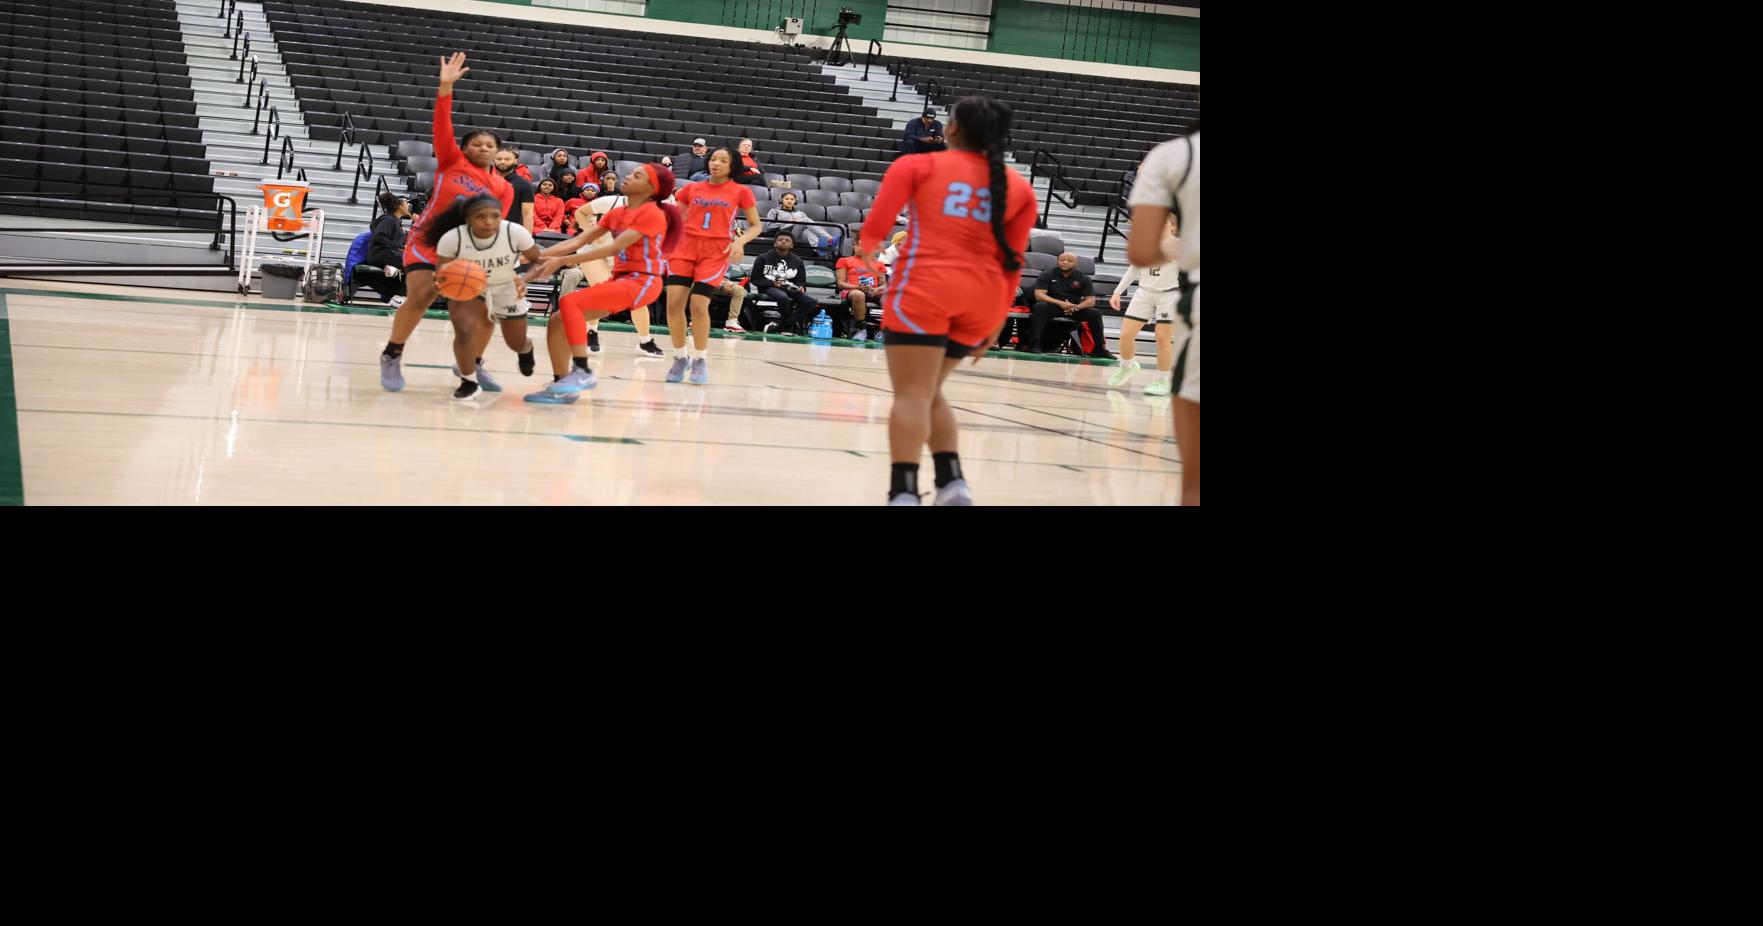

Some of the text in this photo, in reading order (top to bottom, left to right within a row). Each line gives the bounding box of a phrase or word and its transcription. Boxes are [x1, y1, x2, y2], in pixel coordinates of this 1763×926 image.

[273, 192, 291, 208] G
[943, 181, 992, 224] 23
[702, 211, 712, 230] 1
